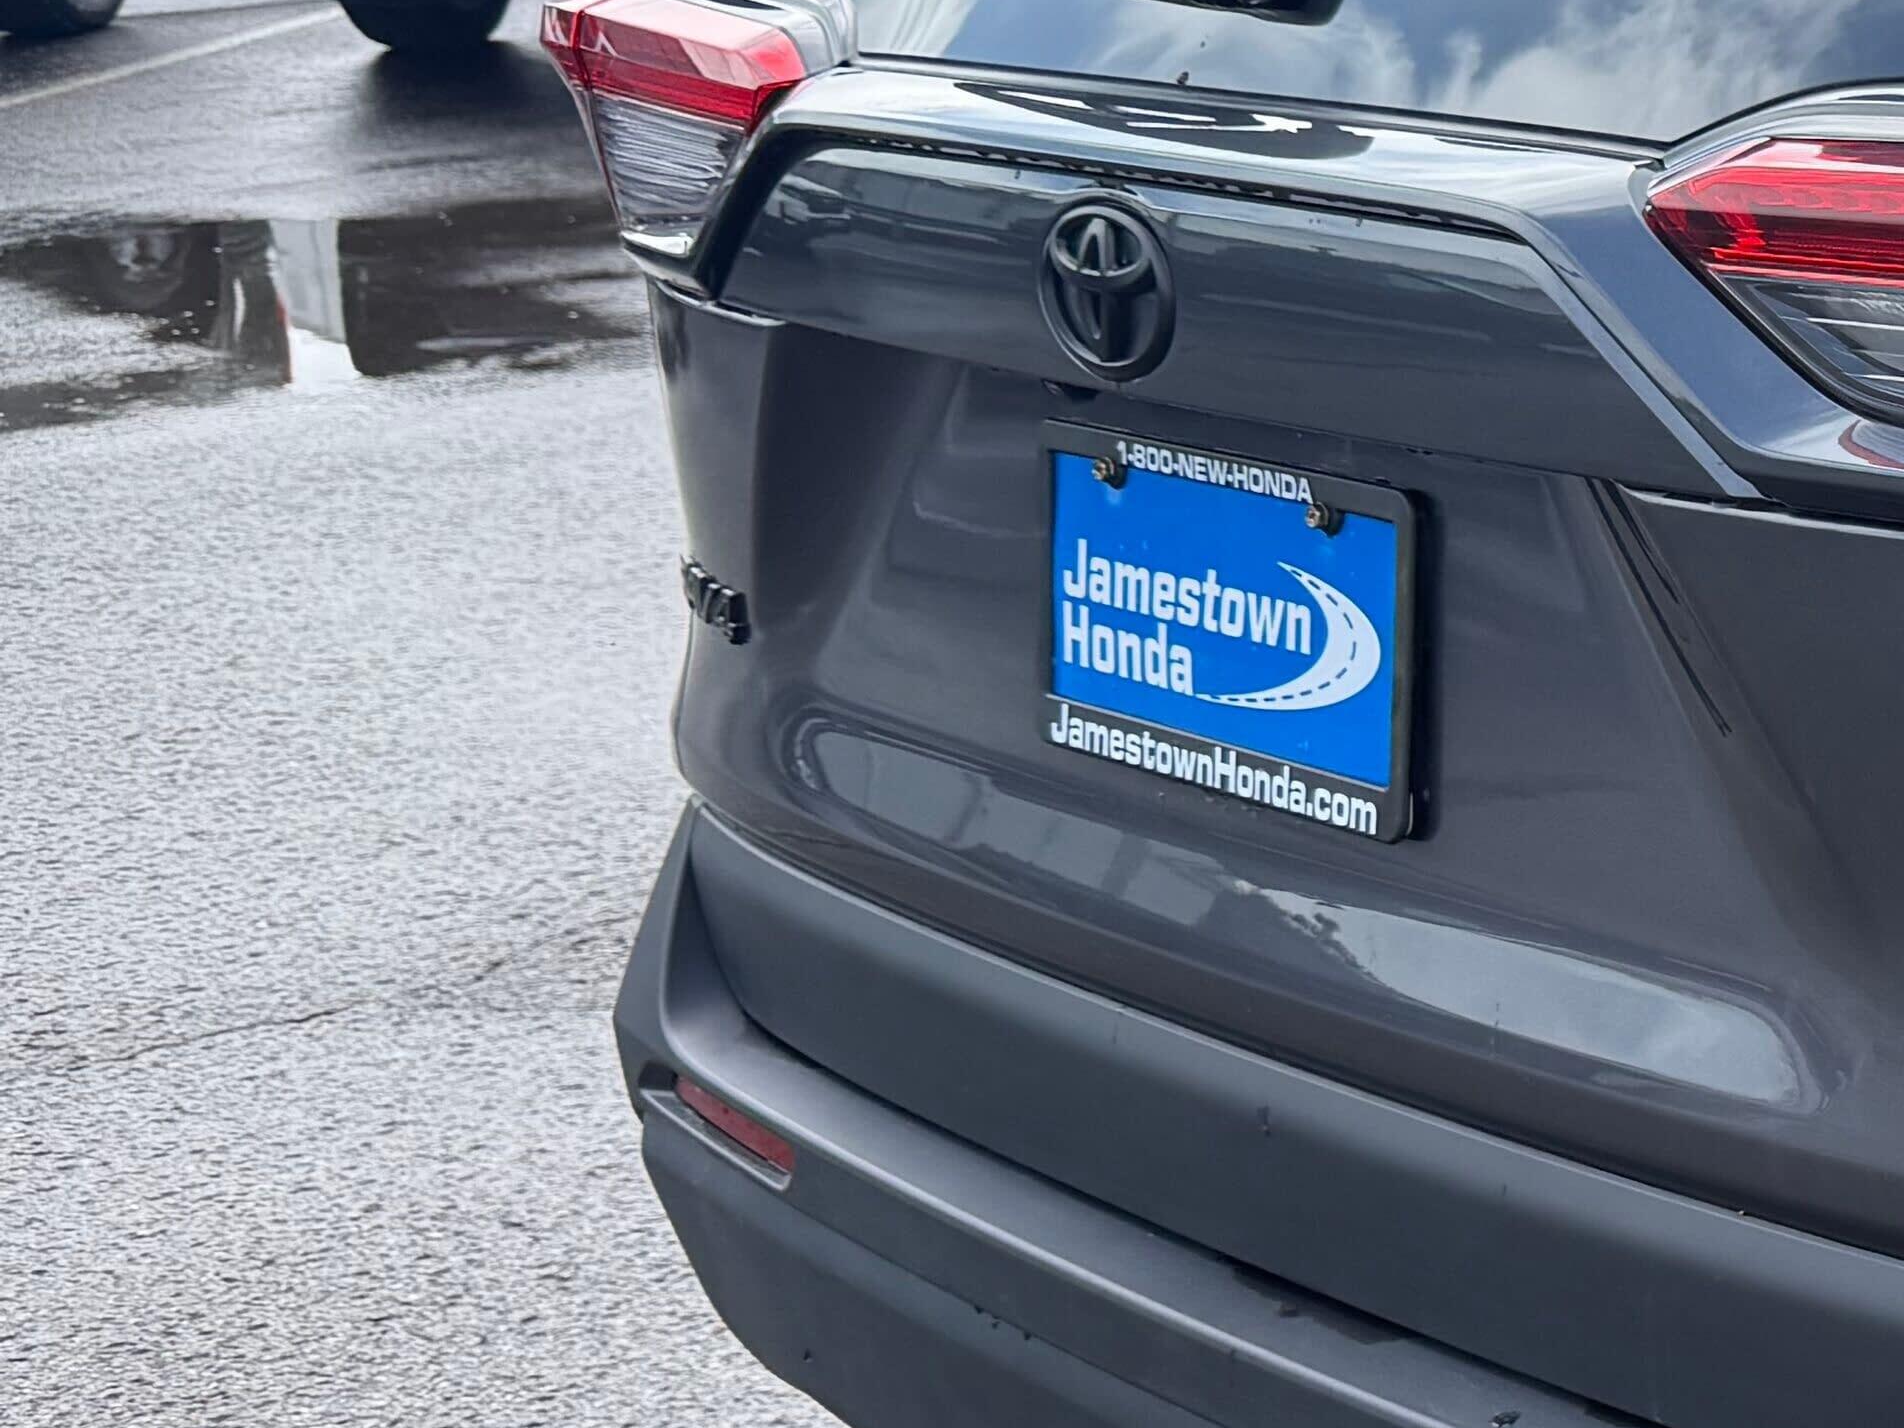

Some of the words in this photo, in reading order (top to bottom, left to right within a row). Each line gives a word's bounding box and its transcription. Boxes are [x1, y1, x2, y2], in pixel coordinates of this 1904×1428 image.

[1117, 440, 1314, 503] 1-800-NEW-HONDA
[1062, 600, 1194, 697] Honda
[1063, 538, 1312, 655] Jamestown
[1051, 703, 1378, 836] JamestownHonda.com
